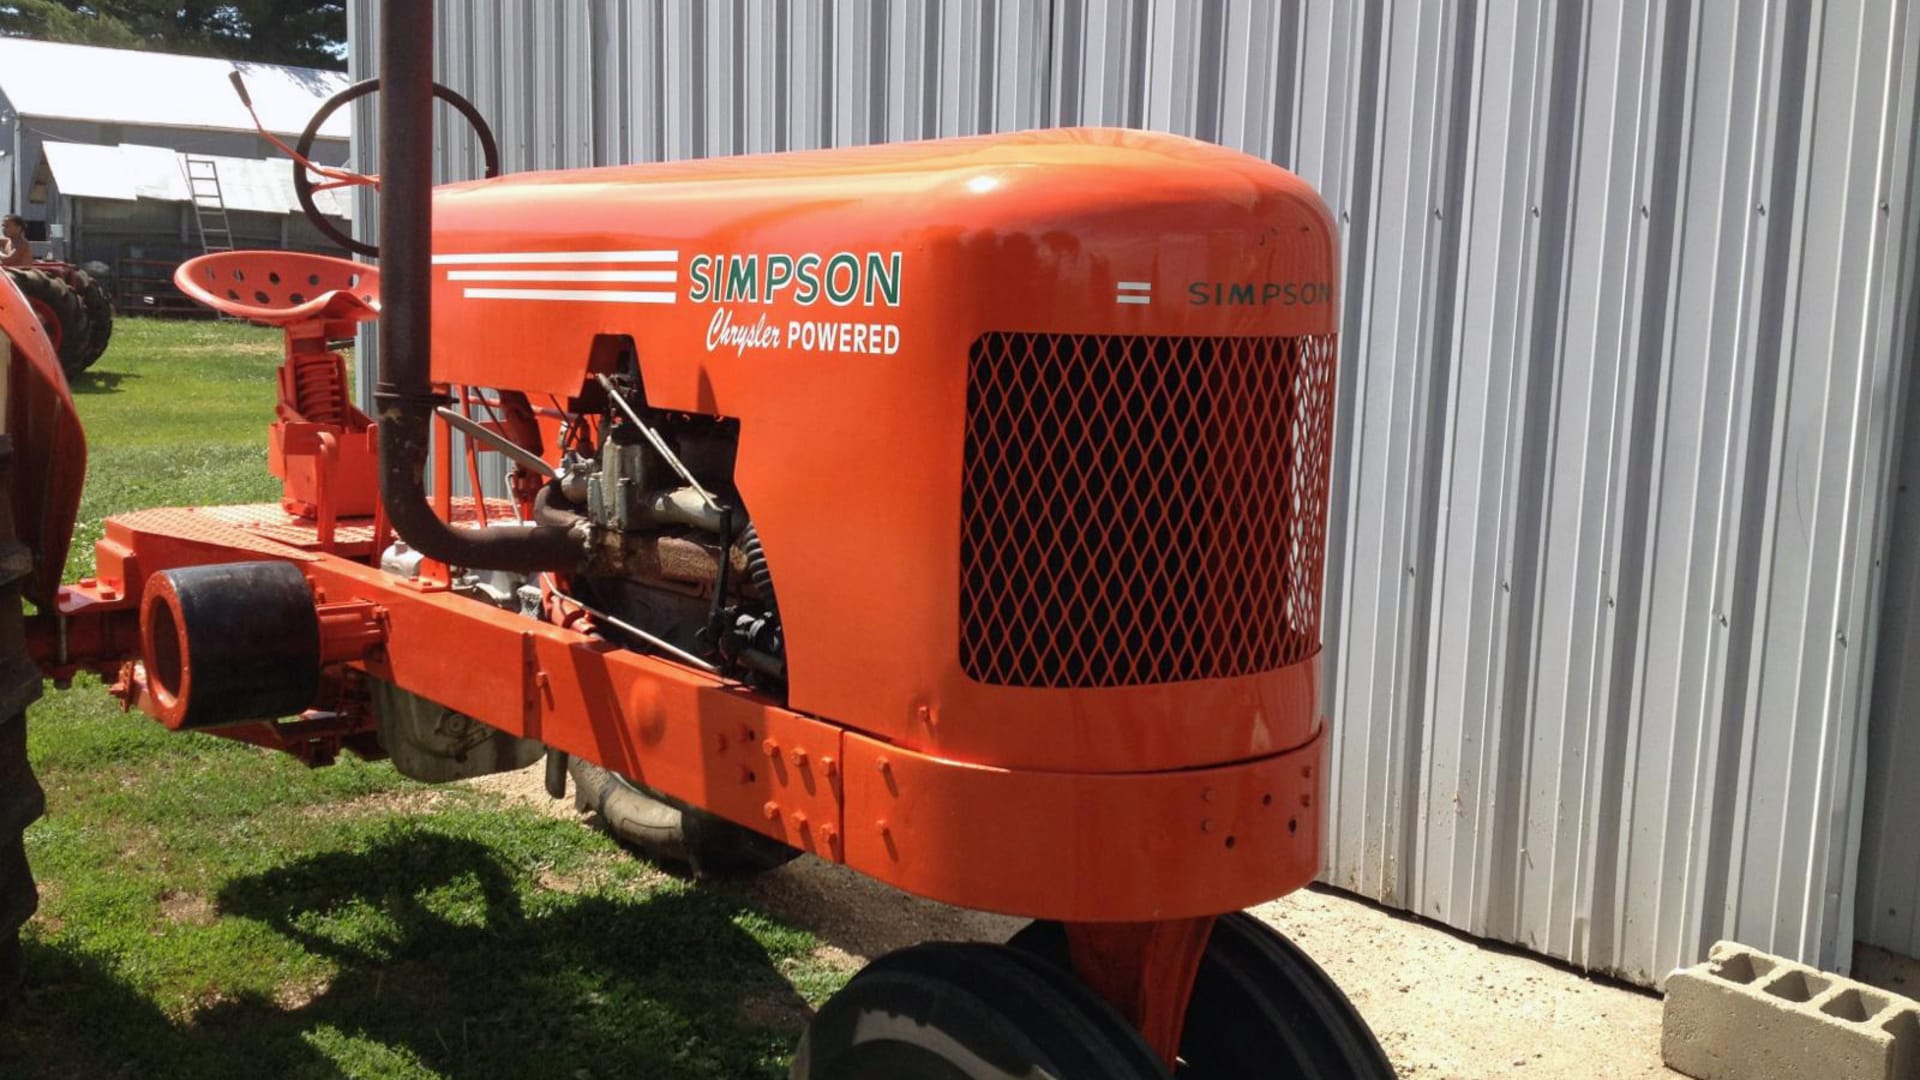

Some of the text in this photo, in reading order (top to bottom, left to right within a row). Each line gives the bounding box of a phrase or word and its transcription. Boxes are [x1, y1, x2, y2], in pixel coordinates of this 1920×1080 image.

[689, 251, 902, 307] SIMPSON
[1188, 281, 1331, 305] SIMPSON
[706, 307, 900, 358] Chrysler POWERED
